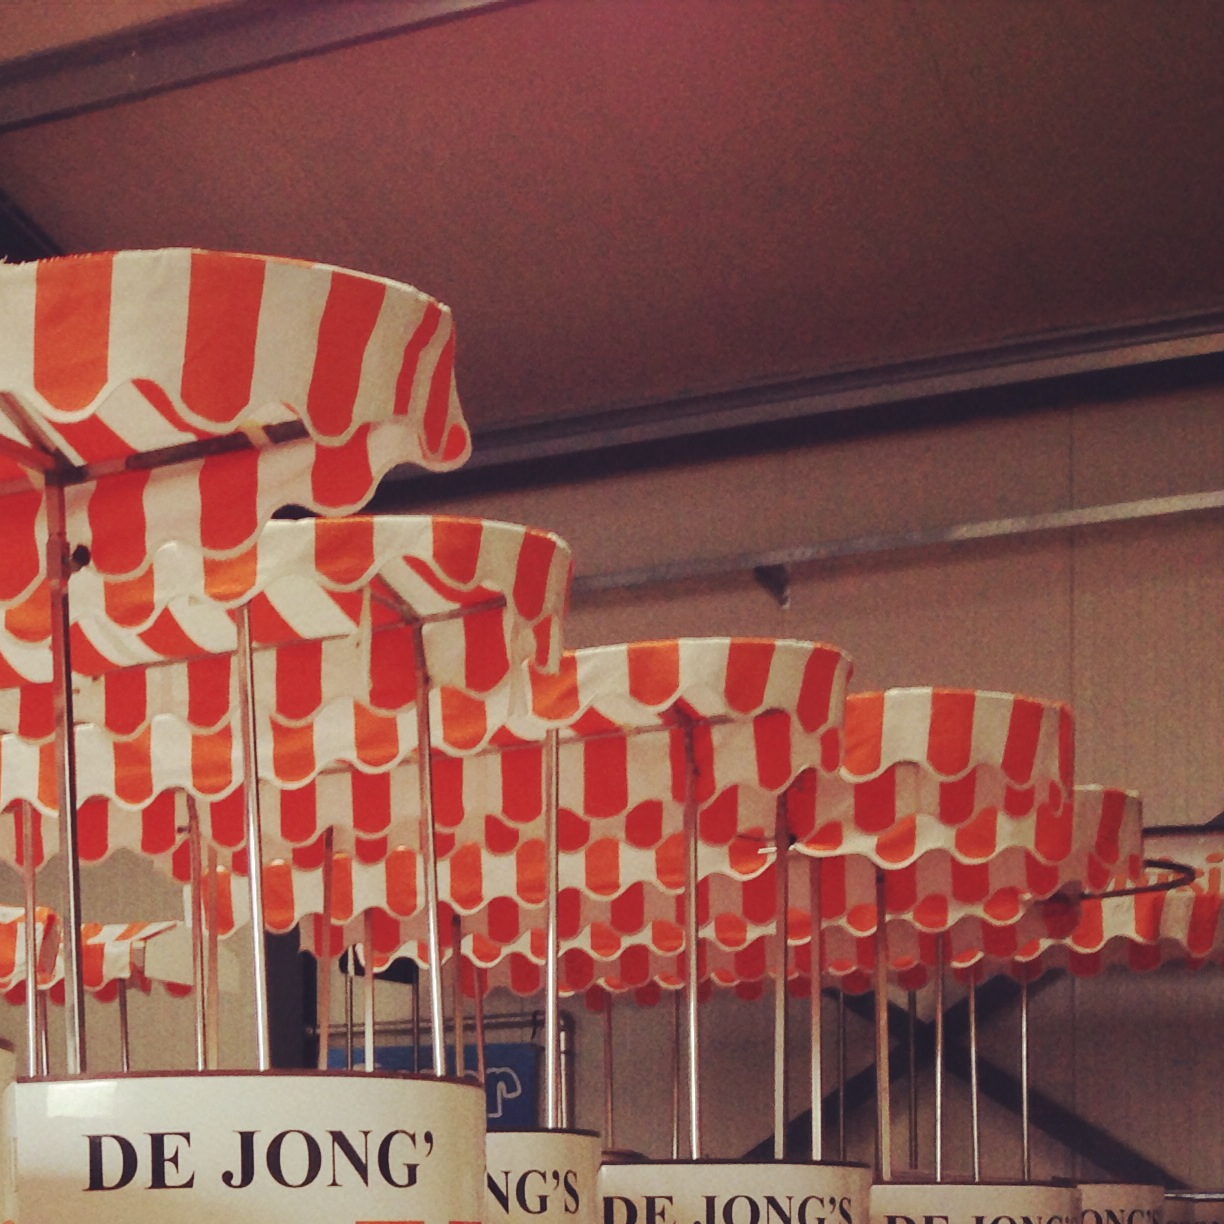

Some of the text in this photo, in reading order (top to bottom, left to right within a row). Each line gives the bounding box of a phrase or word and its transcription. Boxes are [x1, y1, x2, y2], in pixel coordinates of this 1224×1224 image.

[82, 1128, 434, 1192] DE JONG'
[486, 1168, 580, 1216] NG'S
